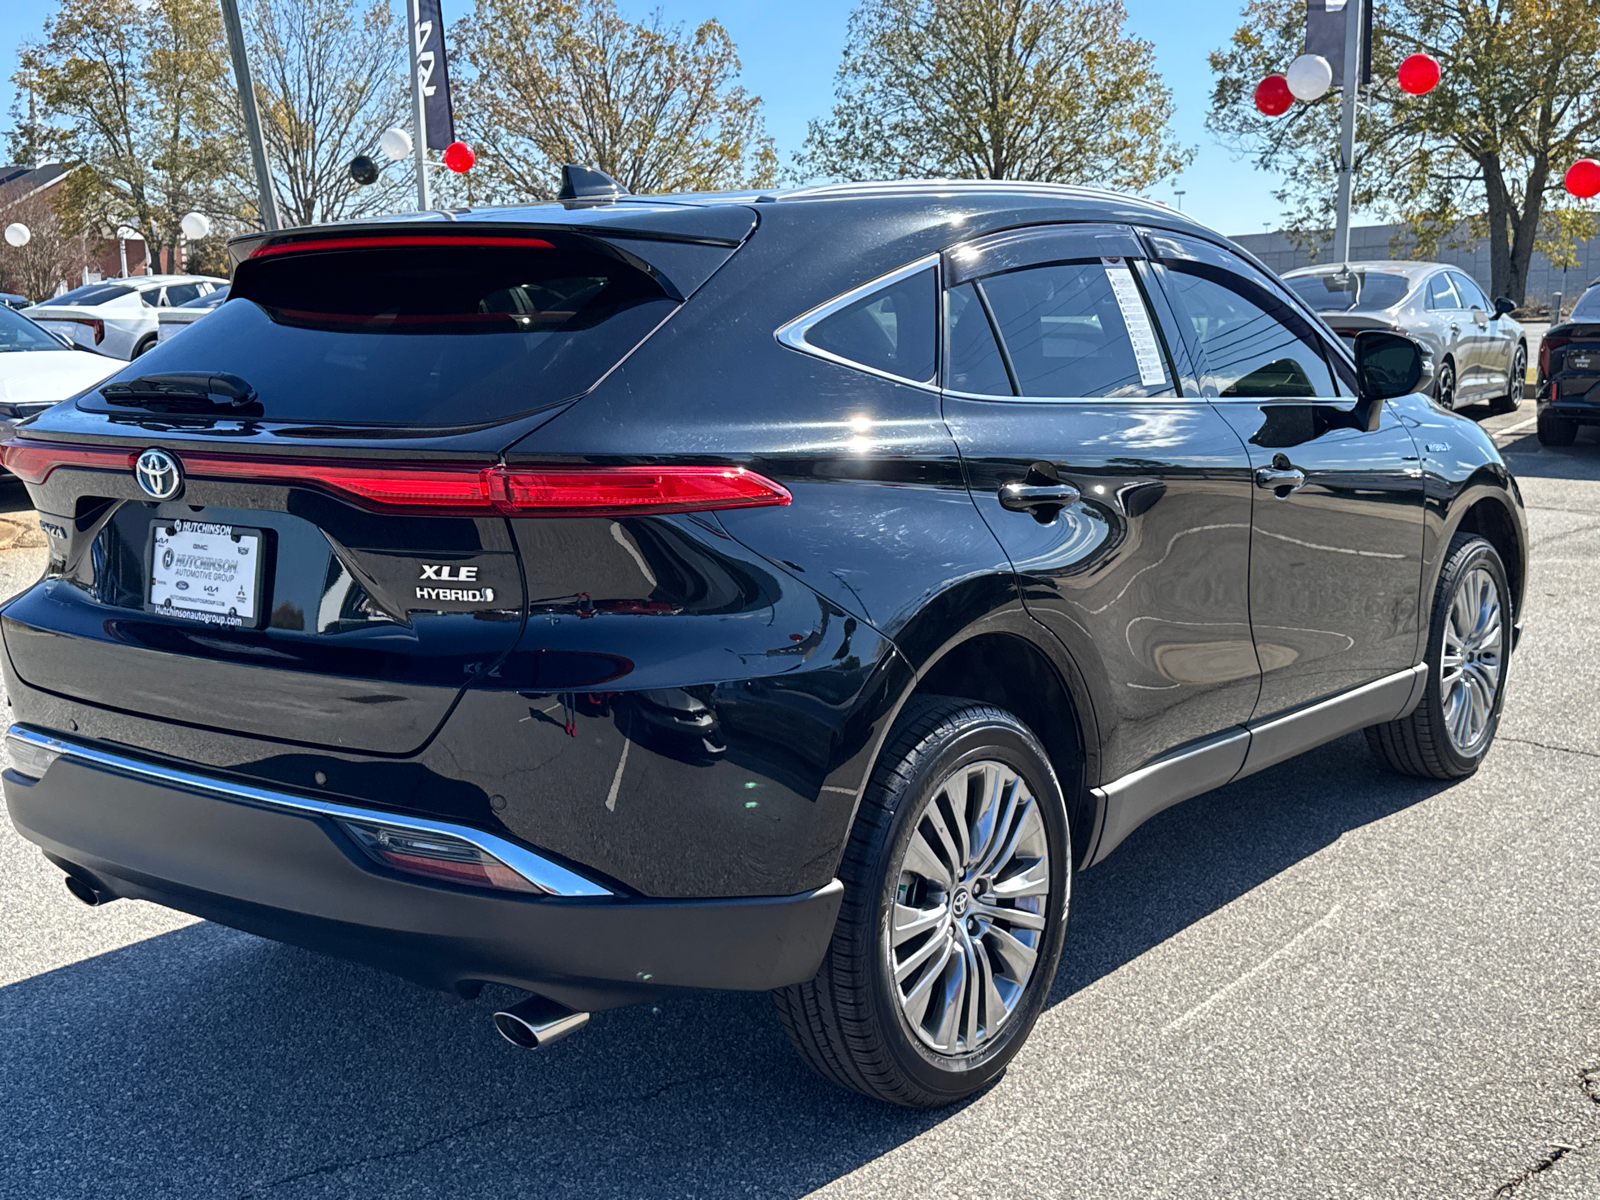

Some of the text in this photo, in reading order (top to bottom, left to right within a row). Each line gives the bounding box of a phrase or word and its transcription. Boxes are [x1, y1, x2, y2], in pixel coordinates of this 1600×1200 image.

[183, 522, 232, 536] HUTCHINSON
[175, 553, 238, 574] HUTCHINSON
[175, 568, 235, 582] AUTOMOTIVE GROUP
[419, 564, 478, 582] XLE
[416, 587, 480, 602] HYBRID
[155, 604, 242, 626] Hutchinsonautogroup.com
